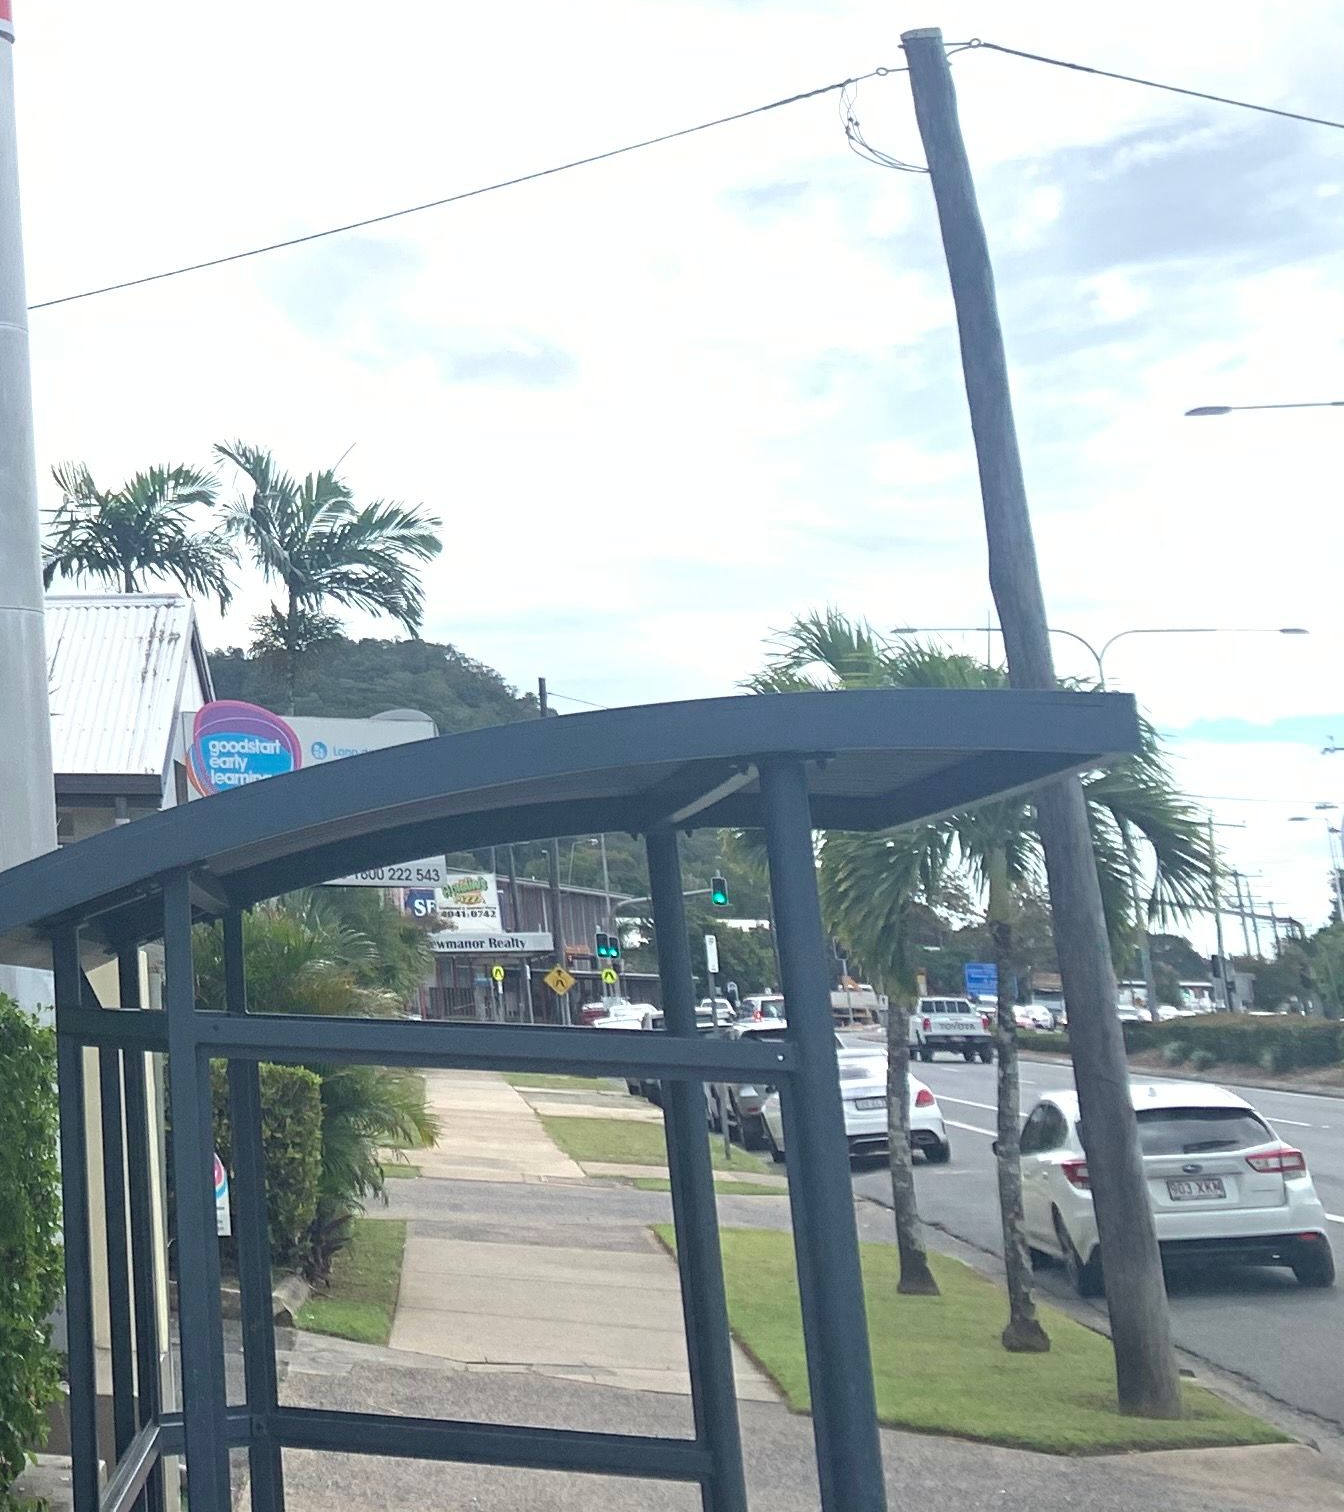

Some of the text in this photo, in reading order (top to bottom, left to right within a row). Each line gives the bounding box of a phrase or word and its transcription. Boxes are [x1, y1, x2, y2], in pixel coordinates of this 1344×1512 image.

[208, 738, 282, 756] goodstart
[209, 755, 248, 772] early
[388, 868, 412, 881] 222
[416, 868, 440, 882] 543
[488, 937, 526, 949] Realty
[940, 1023, 976, 1031] TOYOTA
